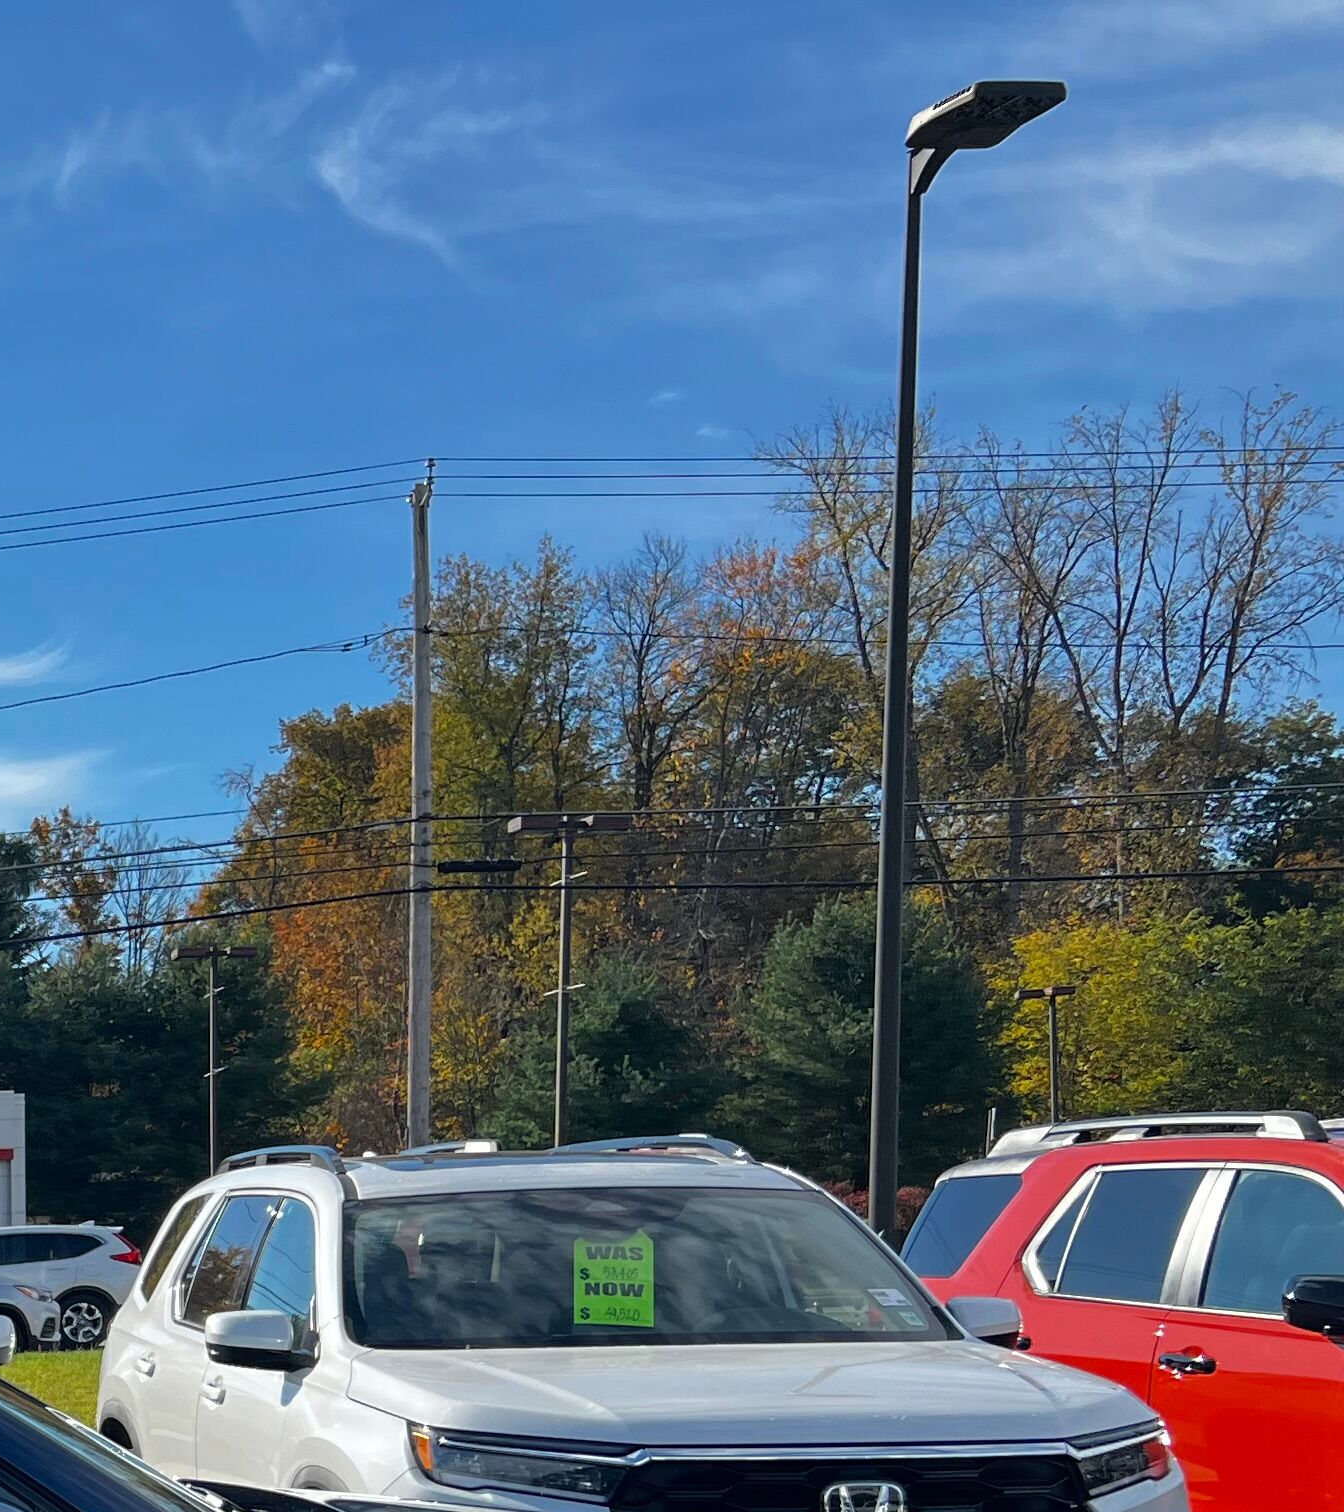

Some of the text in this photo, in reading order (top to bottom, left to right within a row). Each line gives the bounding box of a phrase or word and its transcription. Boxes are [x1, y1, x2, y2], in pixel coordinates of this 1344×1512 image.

[585, 1246, 644, 1261] WAS
[579, 1267, 590, 1281] $
[584, 1282, 645, 1298] NOW
[579, 1307, 590, 1320] $
